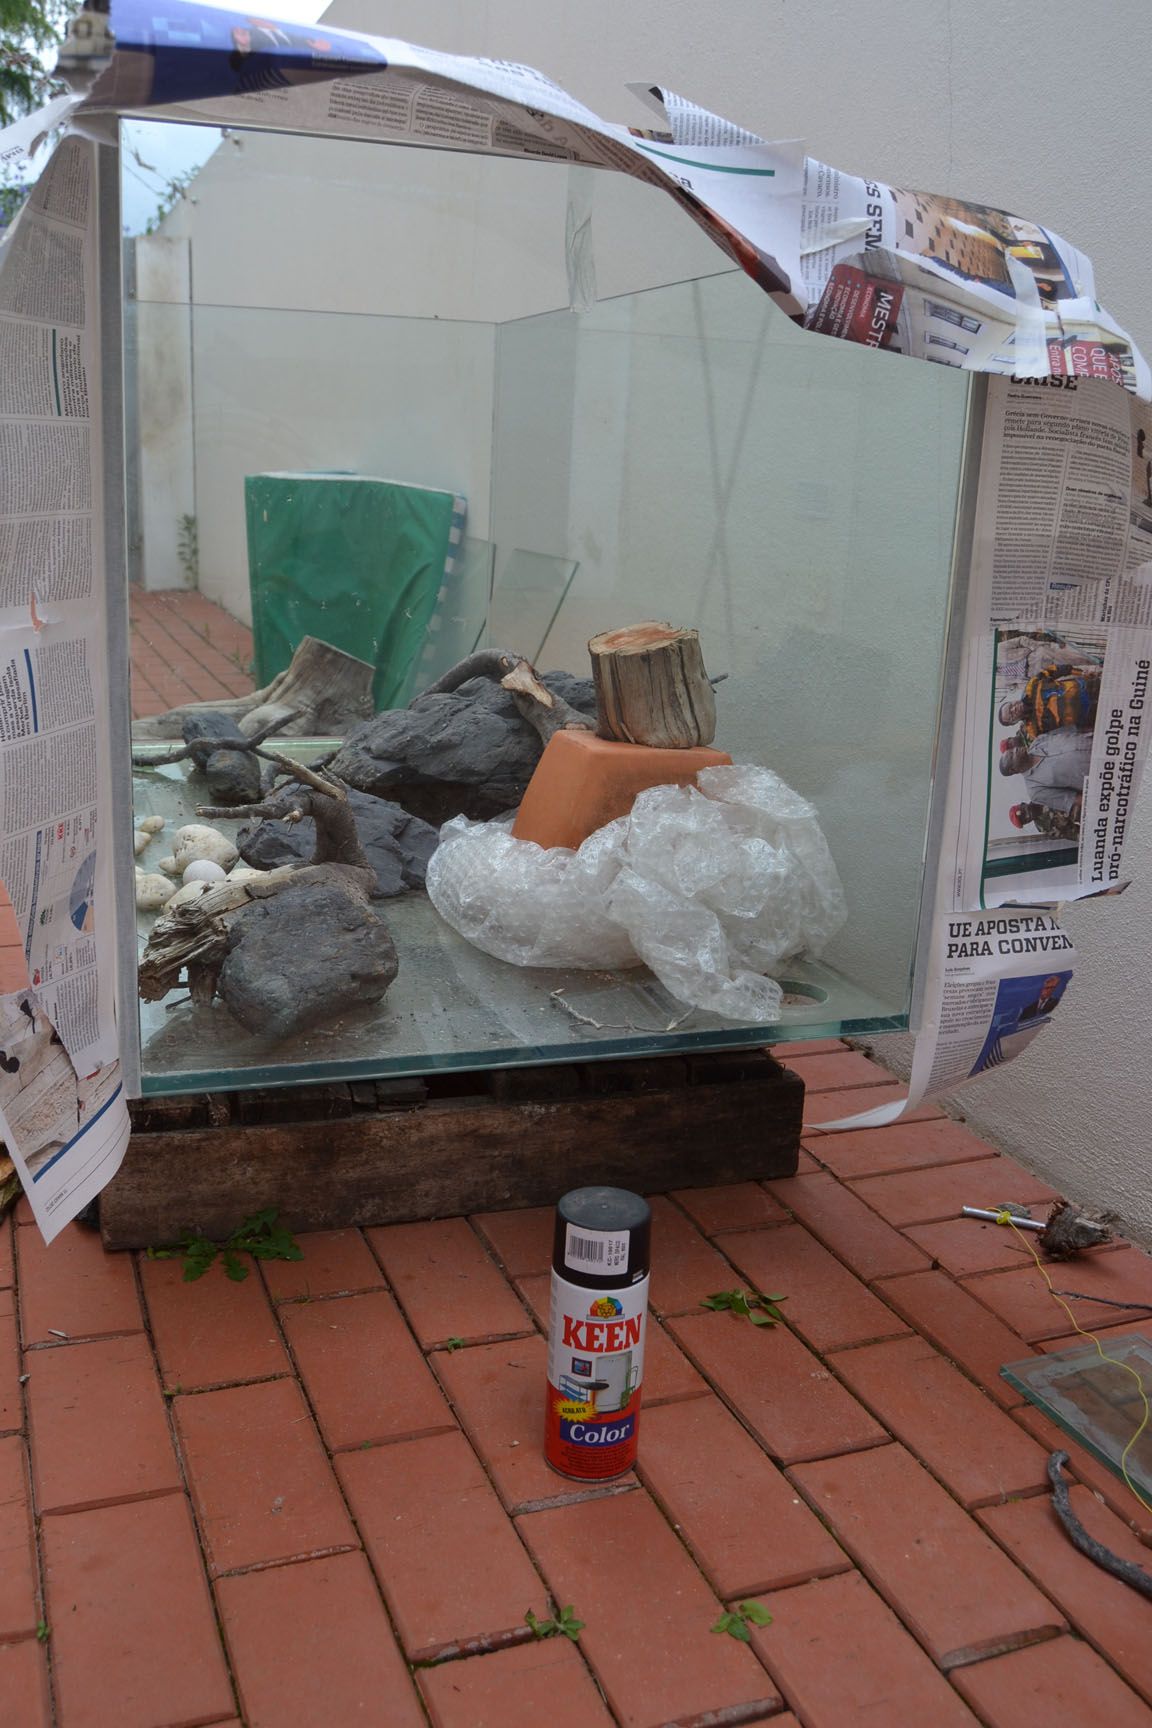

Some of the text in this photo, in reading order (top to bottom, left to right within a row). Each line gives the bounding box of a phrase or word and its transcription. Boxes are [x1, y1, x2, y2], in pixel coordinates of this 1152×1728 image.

[1050, 345, 1061, 369] Entra
[1090, 348, 1107, 371] QUE
[1108, 659, 1150, 880] pró-narcotráfico na Guiné
[1092, 709, 1124, 883] Luanda expõe golpe
[949, 922, 972, 938] UE
[975, 917, 1047, 936] APOSTA
[947, 941, 994, 958] PARA
[562, 1313, 642, 1353] KEEN
[570, 1424, 630, 1443] Color
